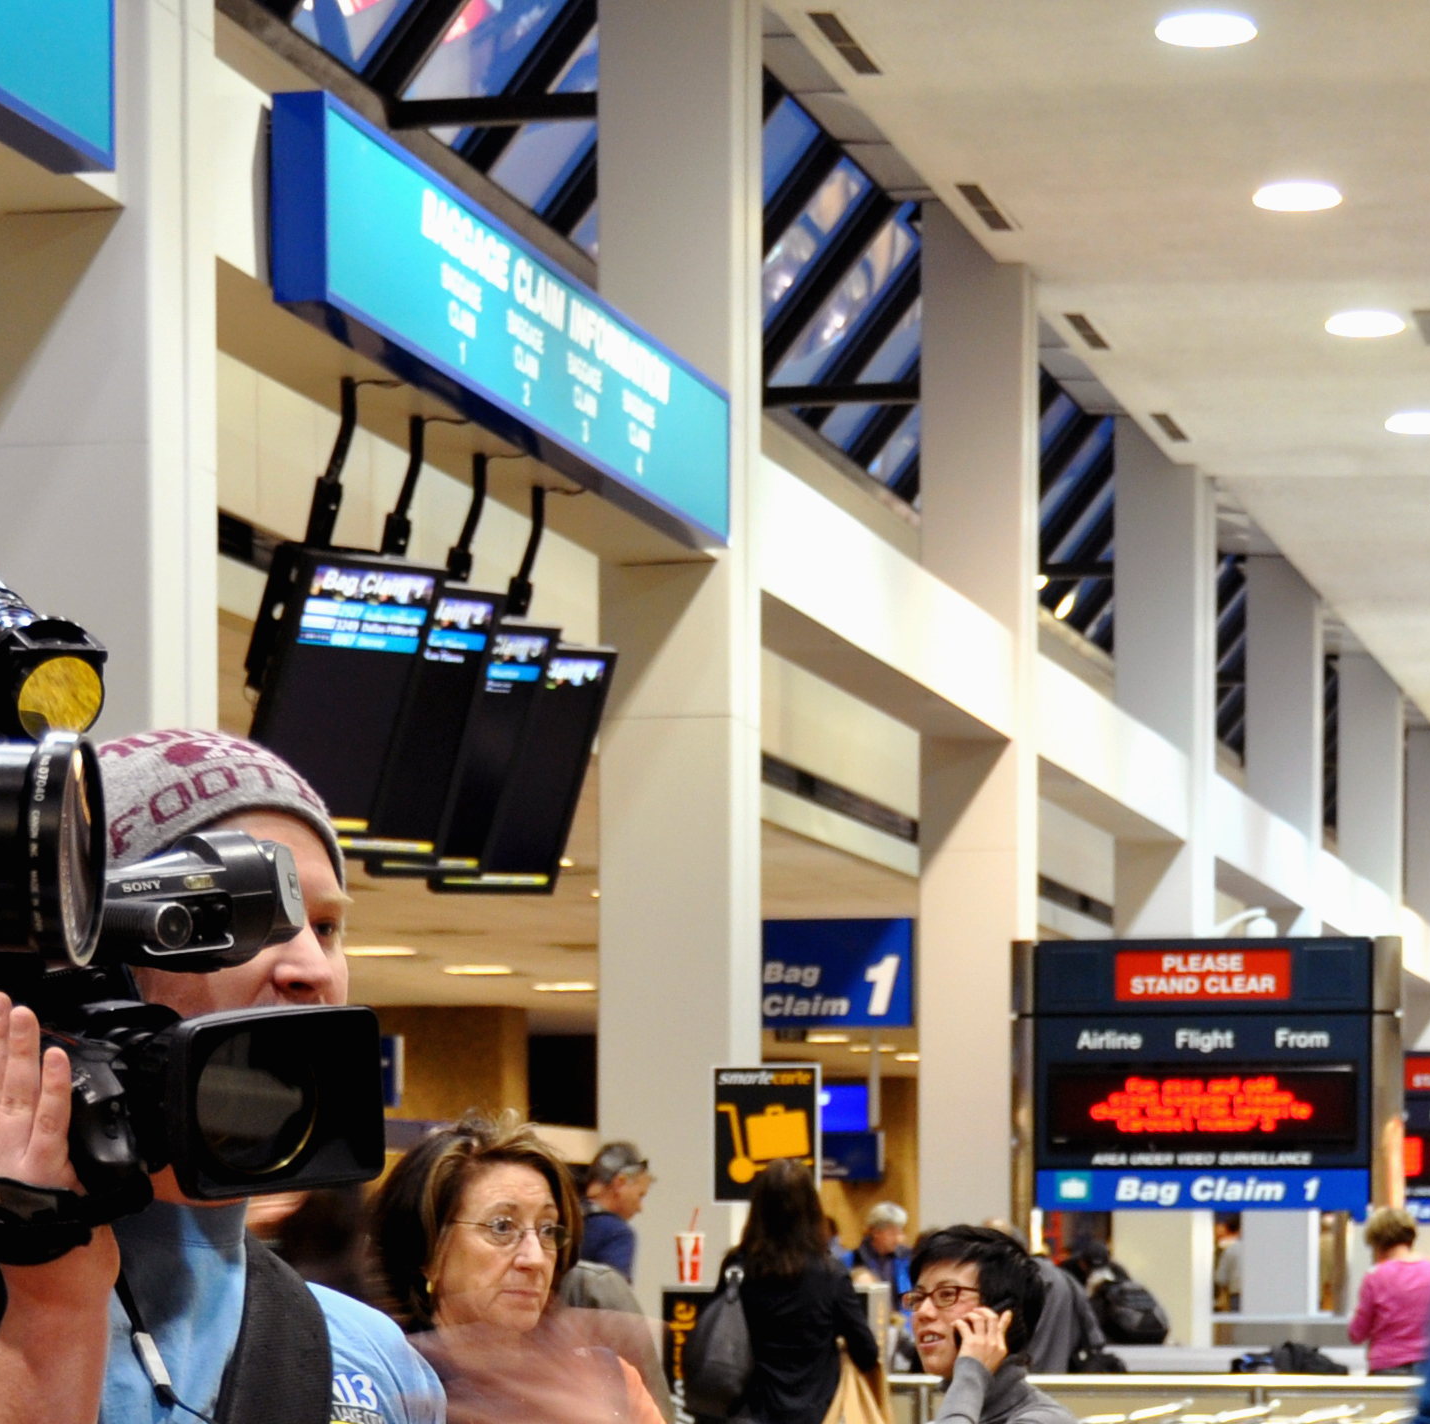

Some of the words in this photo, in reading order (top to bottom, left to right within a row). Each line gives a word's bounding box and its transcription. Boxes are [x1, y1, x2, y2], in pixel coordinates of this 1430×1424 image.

[421, 188, 510, 292] BAGGAGE
[513, 257, 566, 332] CLAIM
[569, 298, 671, 405] INFORMATION
[440, 262, 482, 312] BAGGAGE
[448, 299, 476, 339] CLAIM
[506, 308, 544, 355] BAGGAGE
[514, 344, 540, 381] CLAIM
[567, 350, 603, 394] BAGGAGE
[573, 384, 598, 419] CLAIM
[622, 388, 656, 430] BAGGAGE
[628, 421, 652, 454] CLAIM
[322, 569, 360, 596] Bag
[29, 809, 41, 839] CANON
[122, 879, 161, 893] SONY
[1162, 954, 1243, 973] PLEASE
[763, 961, 820, 984] Bag
[865, 955, 900, 1016] 1
[1130, 976, 1199, 994] STAND
[1206, 975, 1276, 994] CLEAR
[763, 995, 850, 1017] Claim
[1077, 1030, 1142, 1050] Airline
[1175, 1029, 1234, 1053] Flight
[1275, 1029, 1329, 1049] From
[1092, 1153, 1127, 1166] AREA
[1176, 1153, 1214, 1166] VIDEO
[1217, 1152, 1313, 1166] SURVEILLANCE
[1116, 1177, 1181, 1205] Bag
[1190, 1177, 1286, 1202] Claim
[1302, 1177, 1320, 1201] 1
